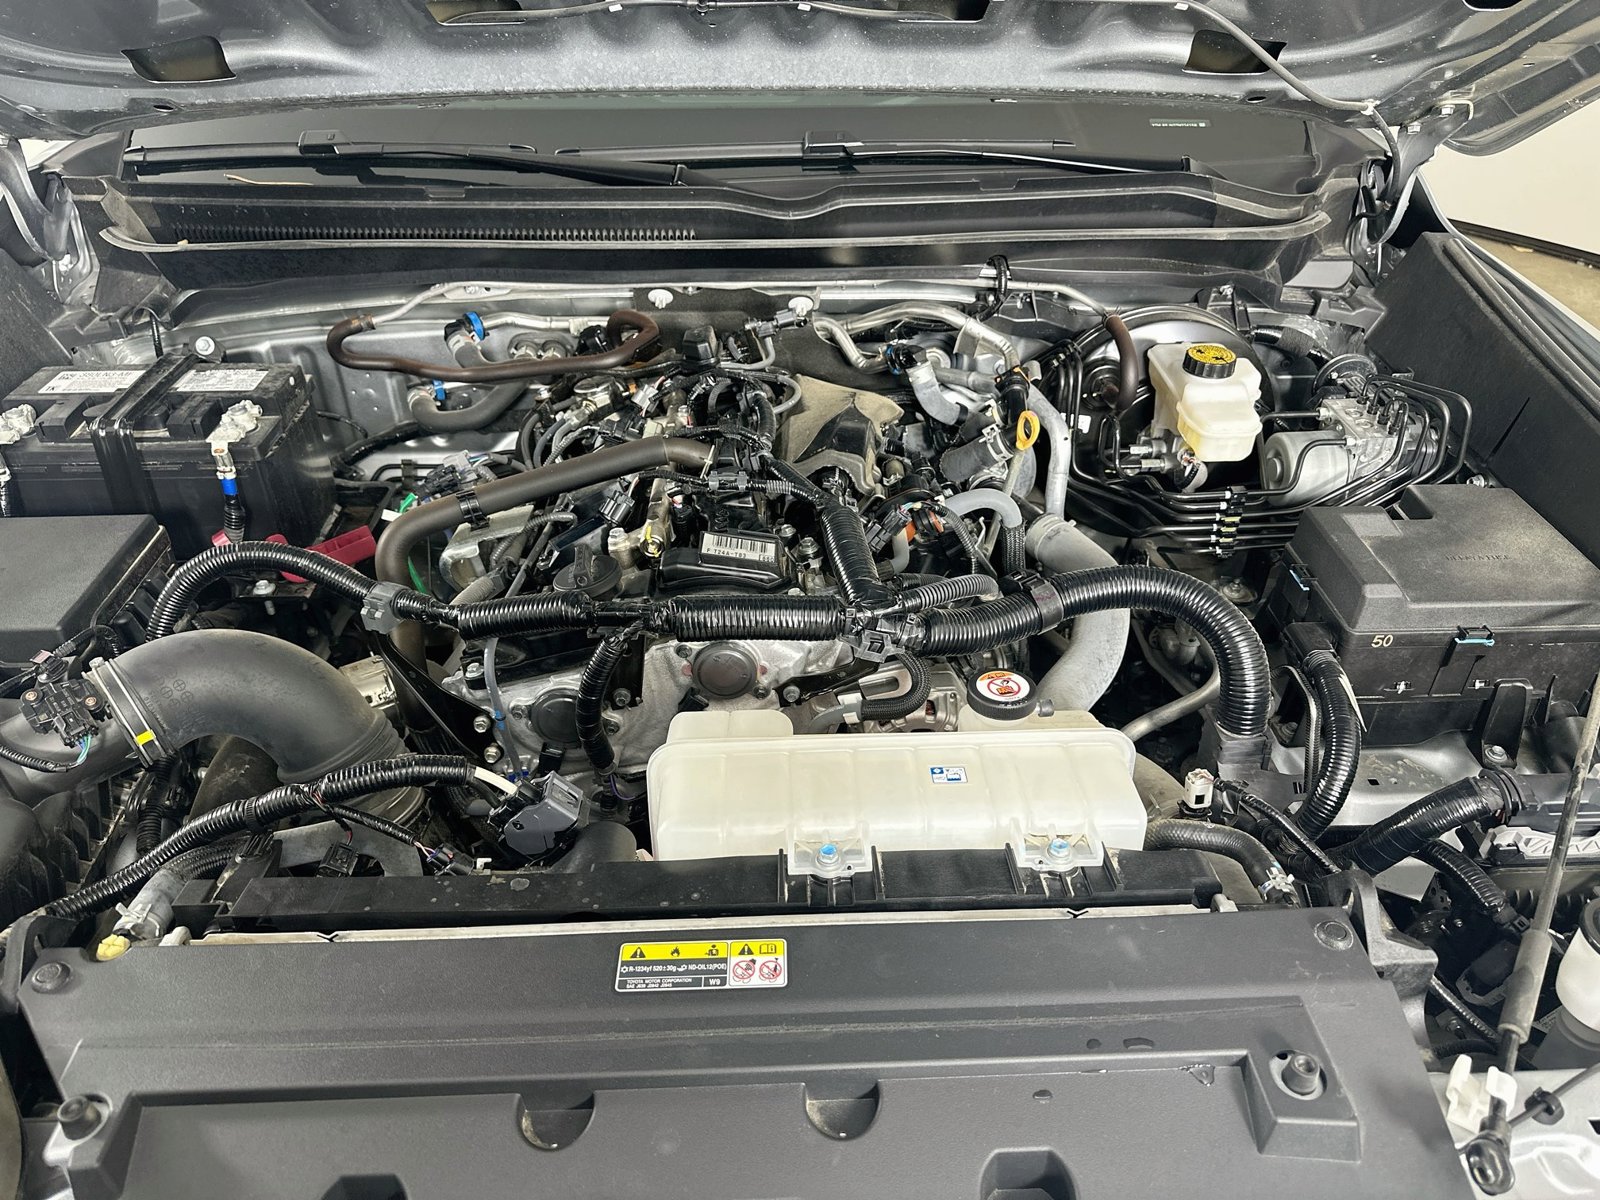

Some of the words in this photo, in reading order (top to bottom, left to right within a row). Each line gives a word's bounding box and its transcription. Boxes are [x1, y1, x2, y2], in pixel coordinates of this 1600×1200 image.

[1371, 634, 1394, 648] 50
[628, 964, 652, 973] R-1234yf
[708, 978, 721, 986] W9
